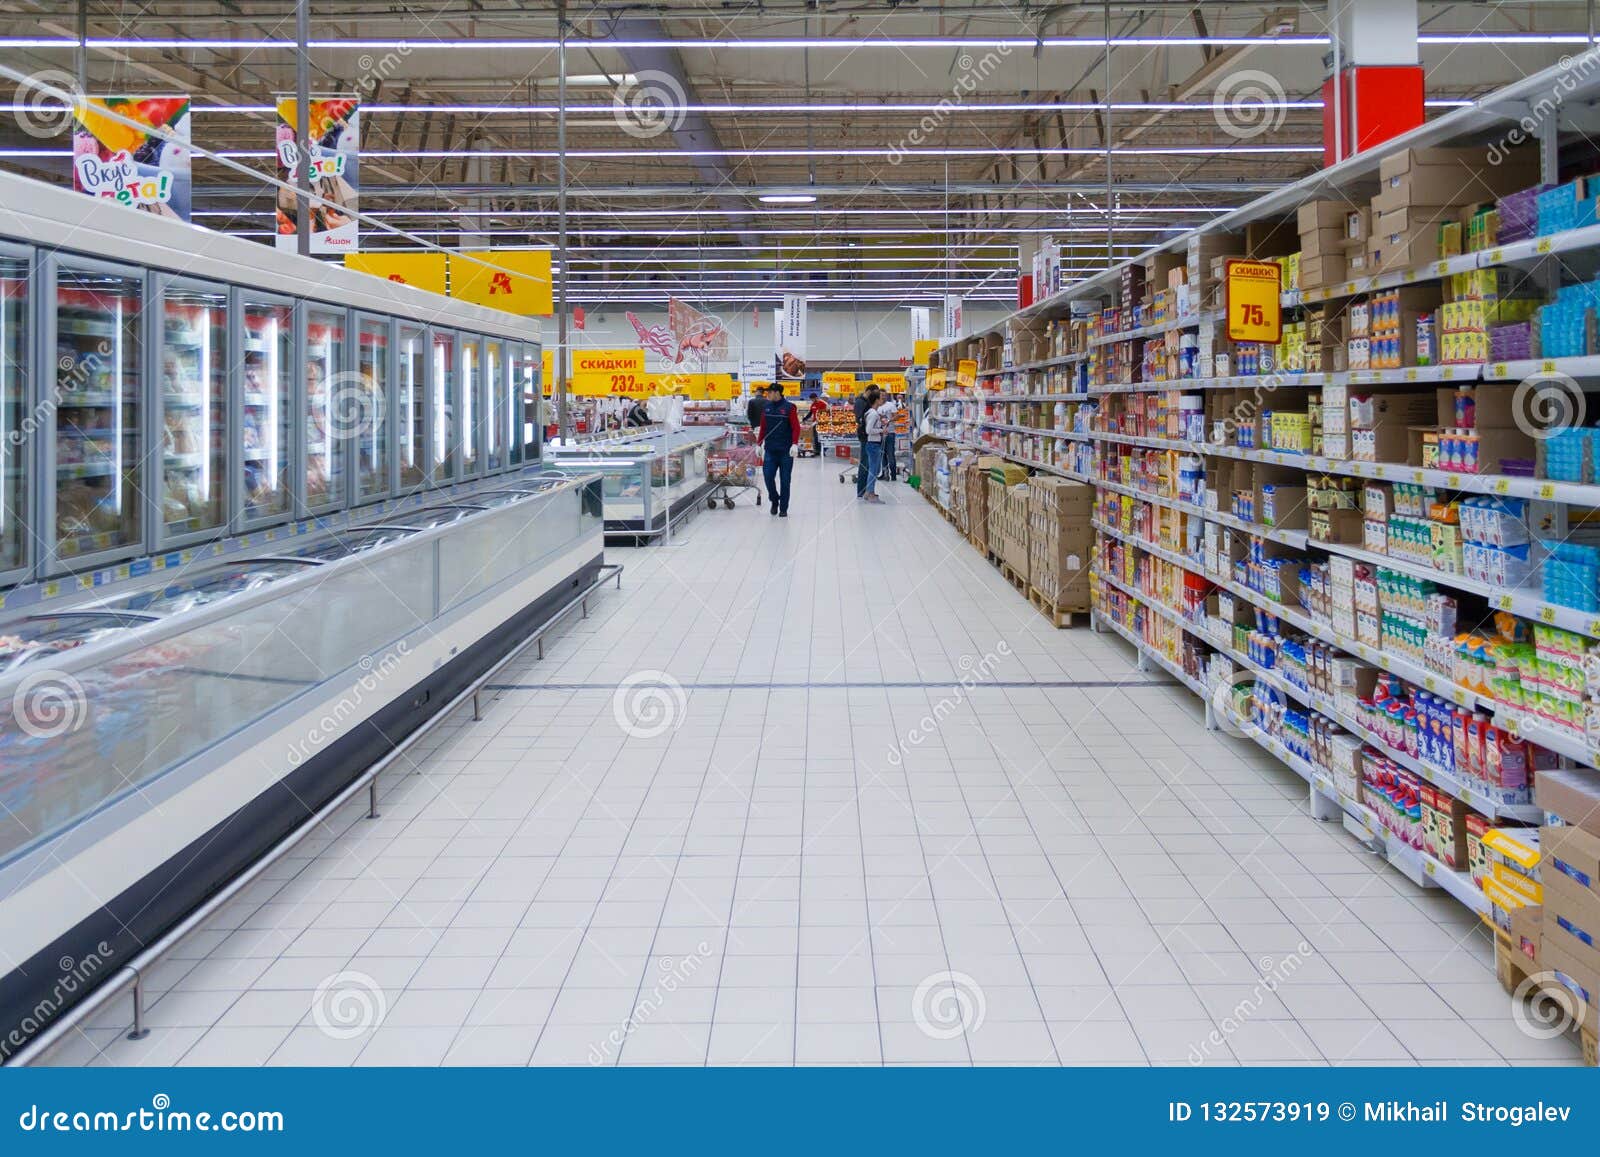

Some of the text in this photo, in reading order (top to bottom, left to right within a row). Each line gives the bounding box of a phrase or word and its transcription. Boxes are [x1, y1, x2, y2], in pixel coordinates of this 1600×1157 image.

[81, 159, 131, 191] Вкус
[1235, 266, 1274, 276] СКИДКИ!
[580, 359, 637, 370] СКИДКИ!
[611, 375, 635, 392] 232
